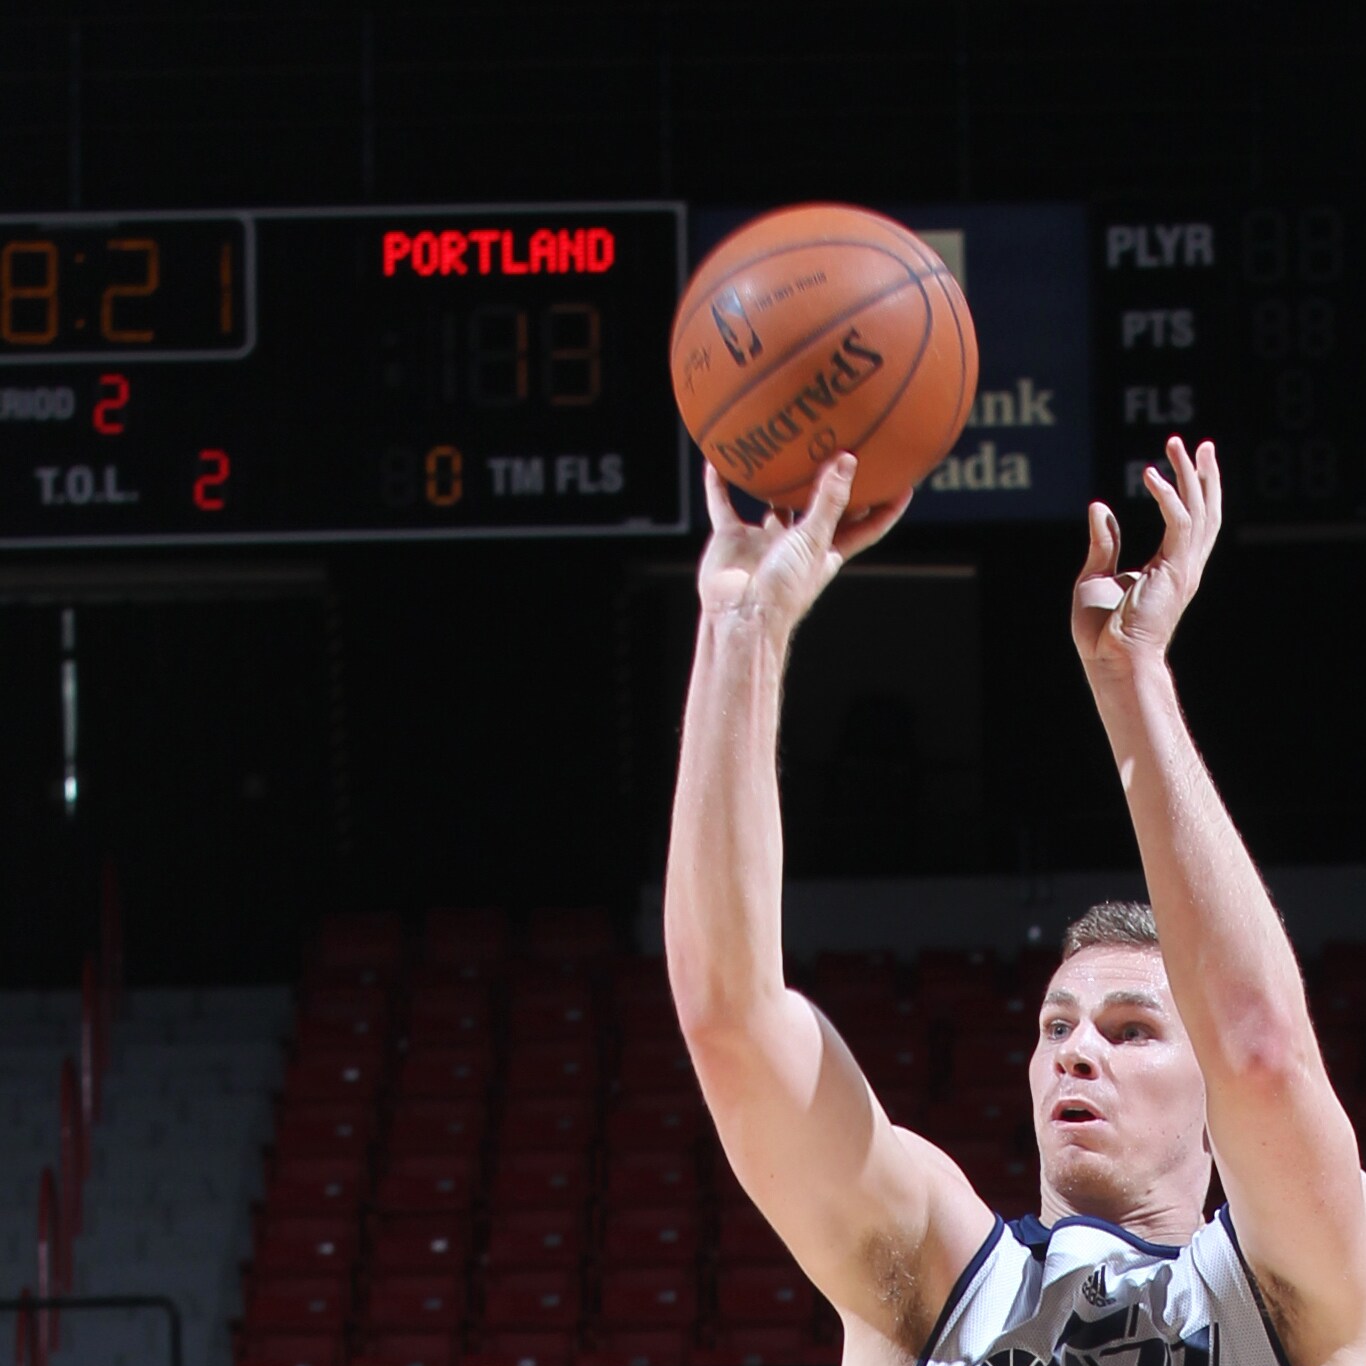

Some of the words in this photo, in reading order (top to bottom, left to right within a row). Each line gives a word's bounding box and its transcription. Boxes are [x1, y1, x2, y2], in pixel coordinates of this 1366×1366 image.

[382, 227, 616, 277] PORTLAND
[1106, 221, 1215, 269] PLYR
[1120, 307, 1196, 350] PTS
[91, 372, 131, 436] 2
[711, 326, 884, 480] SPALDING
[967, 376, 1056, 427] nk
[1123, 384, 1195, 425] FLS
[192, 447, 232, 512] 2
[486, 455, 545, 497] TM
[554, 452, 625, 496] FLS
[918, 440, 1032, 491] ada
